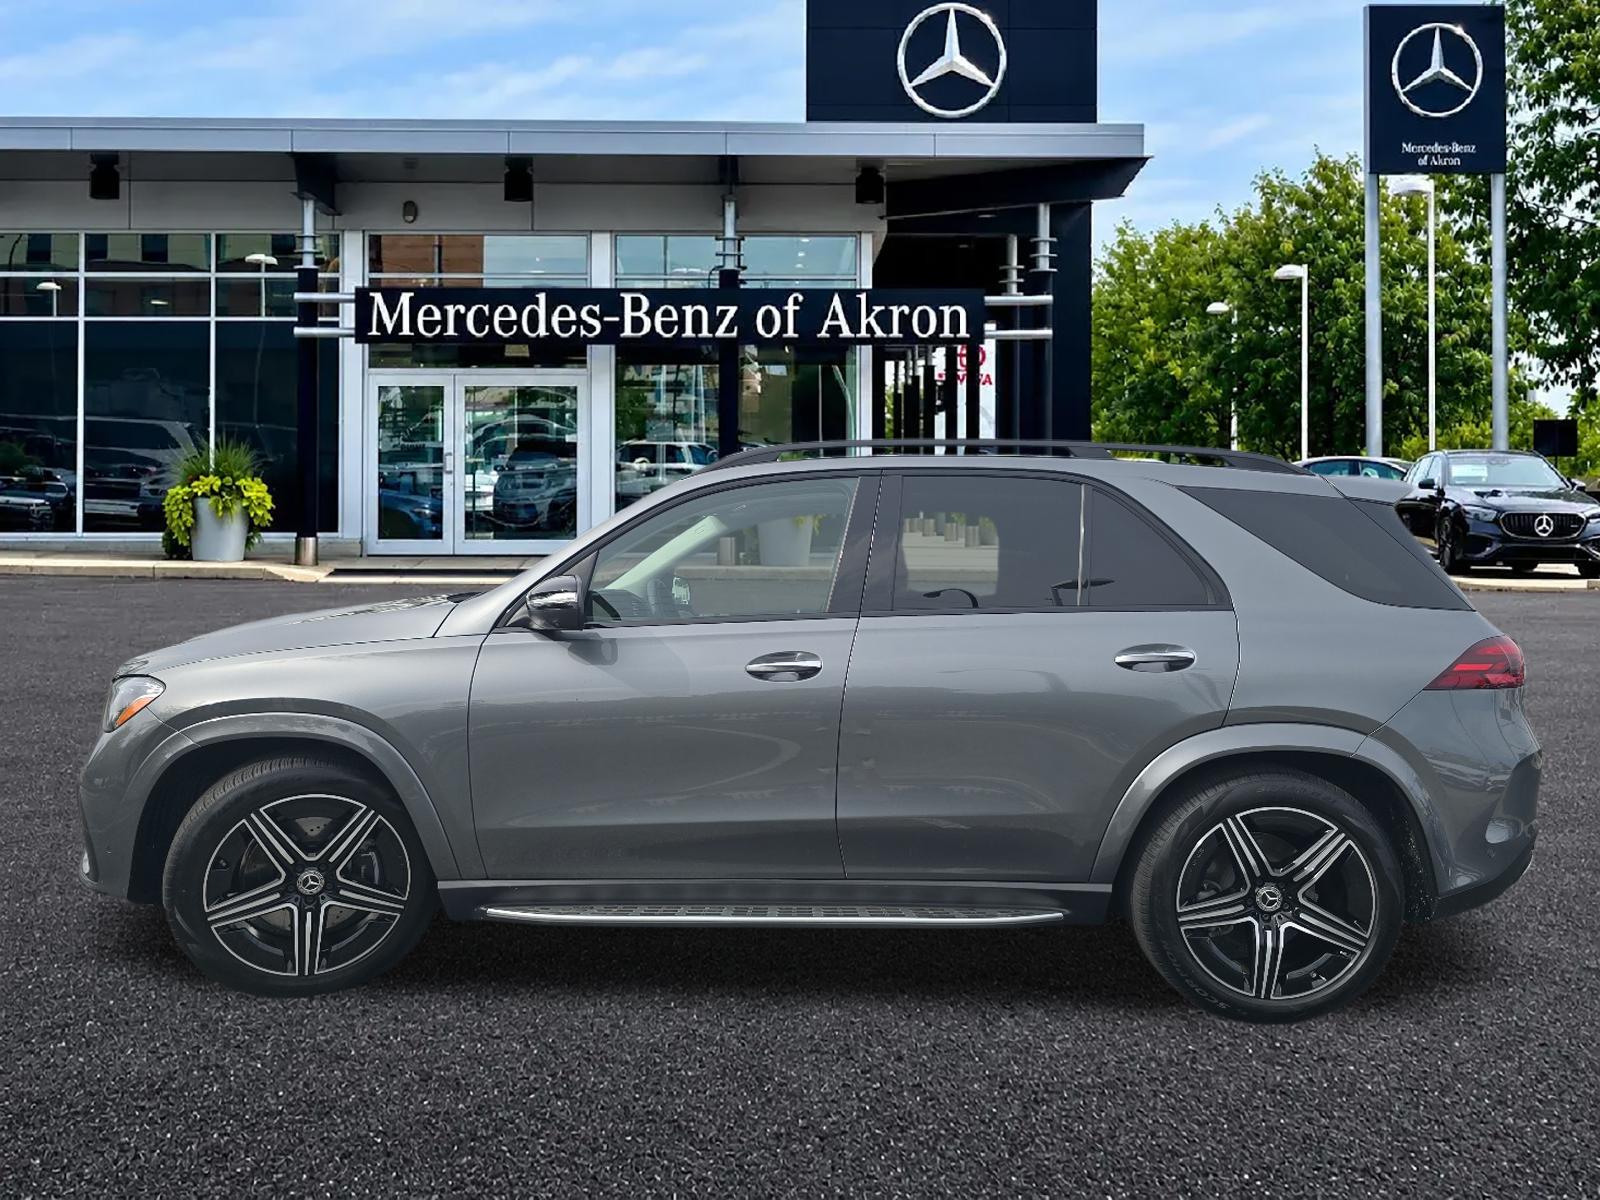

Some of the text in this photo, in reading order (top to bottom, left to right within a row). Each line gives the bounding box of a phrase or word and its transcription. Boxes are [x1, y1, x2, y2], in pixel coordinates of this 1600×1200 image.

[1401, 141, 1477, 154] Mercedes-Benz
[1417, 154, 1461, 166] of Akron
[367, 290, 970, 339] Mercedes-Benz of Akron
